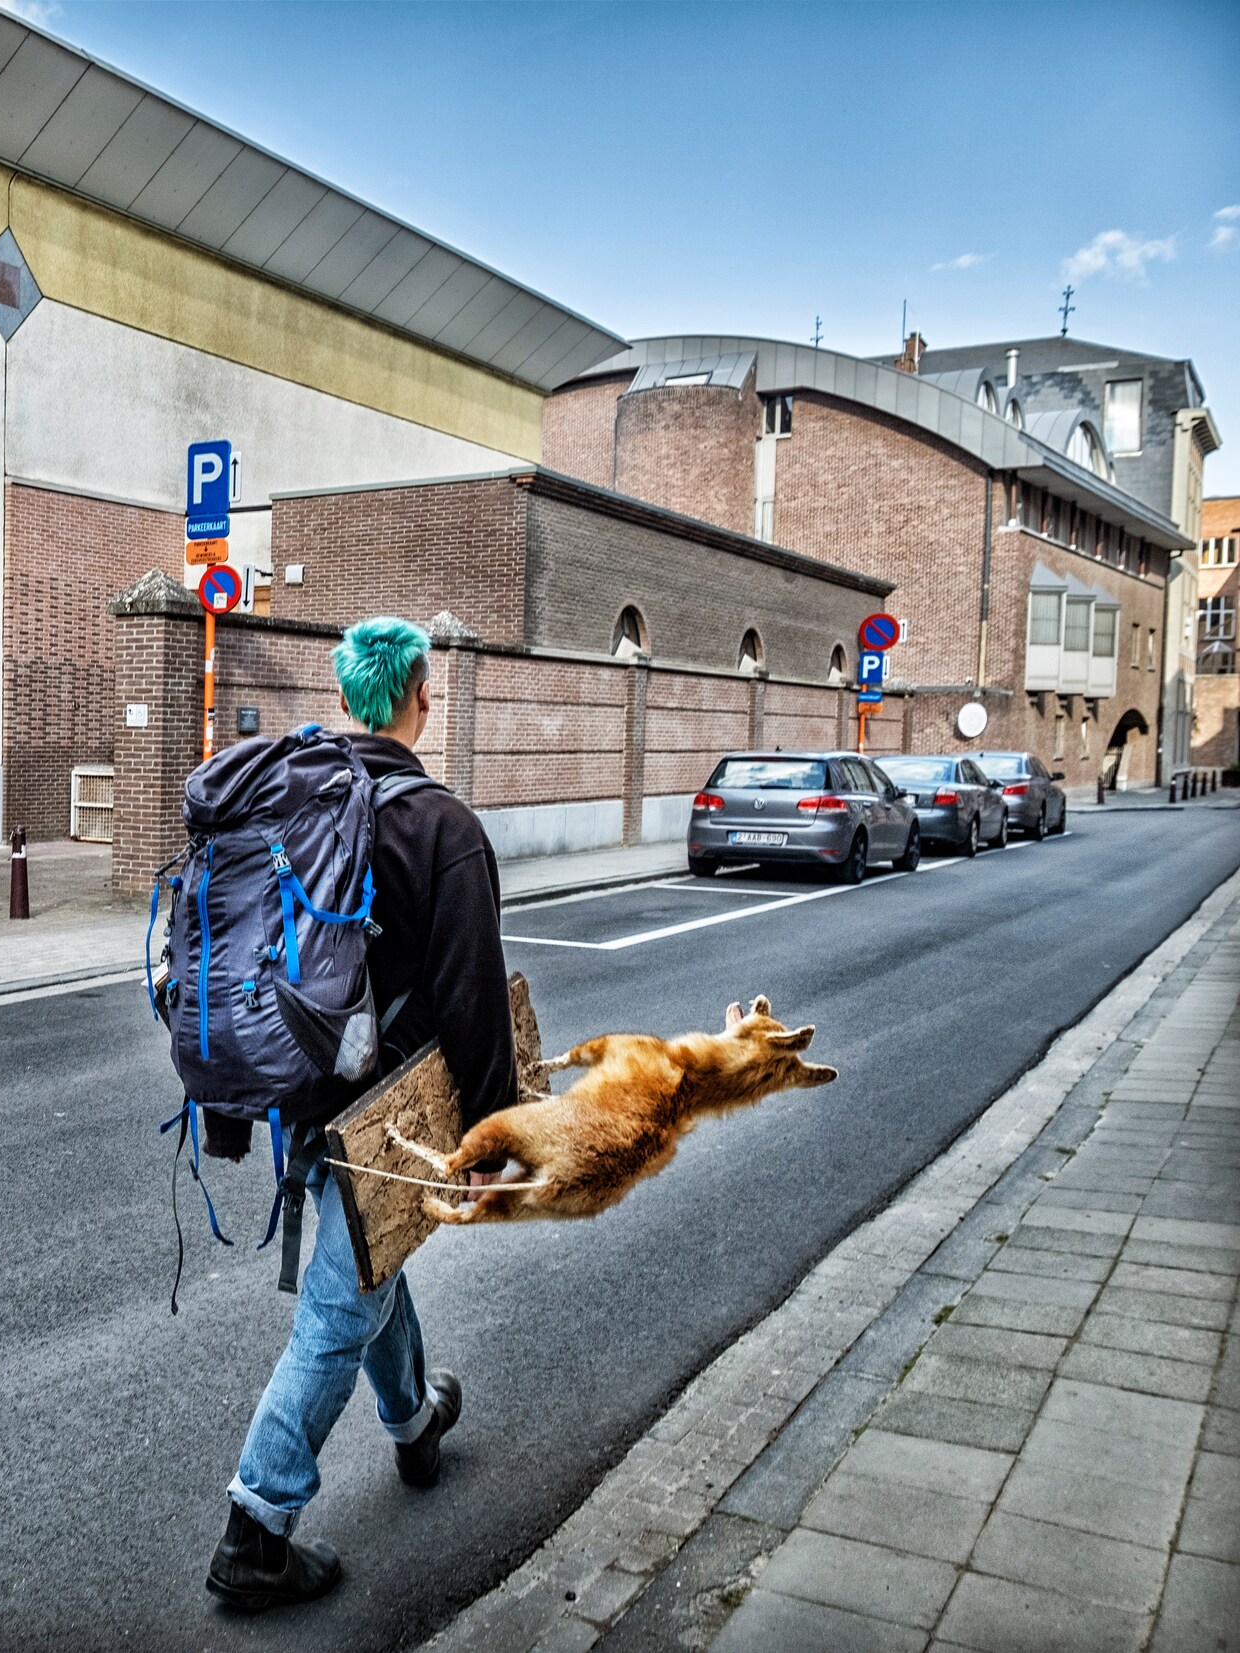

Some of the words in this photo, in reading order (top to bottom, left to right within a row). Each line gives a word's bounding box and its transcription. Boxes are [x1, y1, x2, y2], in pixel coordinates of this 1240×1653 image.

[193, 453, 223, 504] P
[188, 520, 227, 533] PARKEERKAART
[862, 656, 880, 679] P
